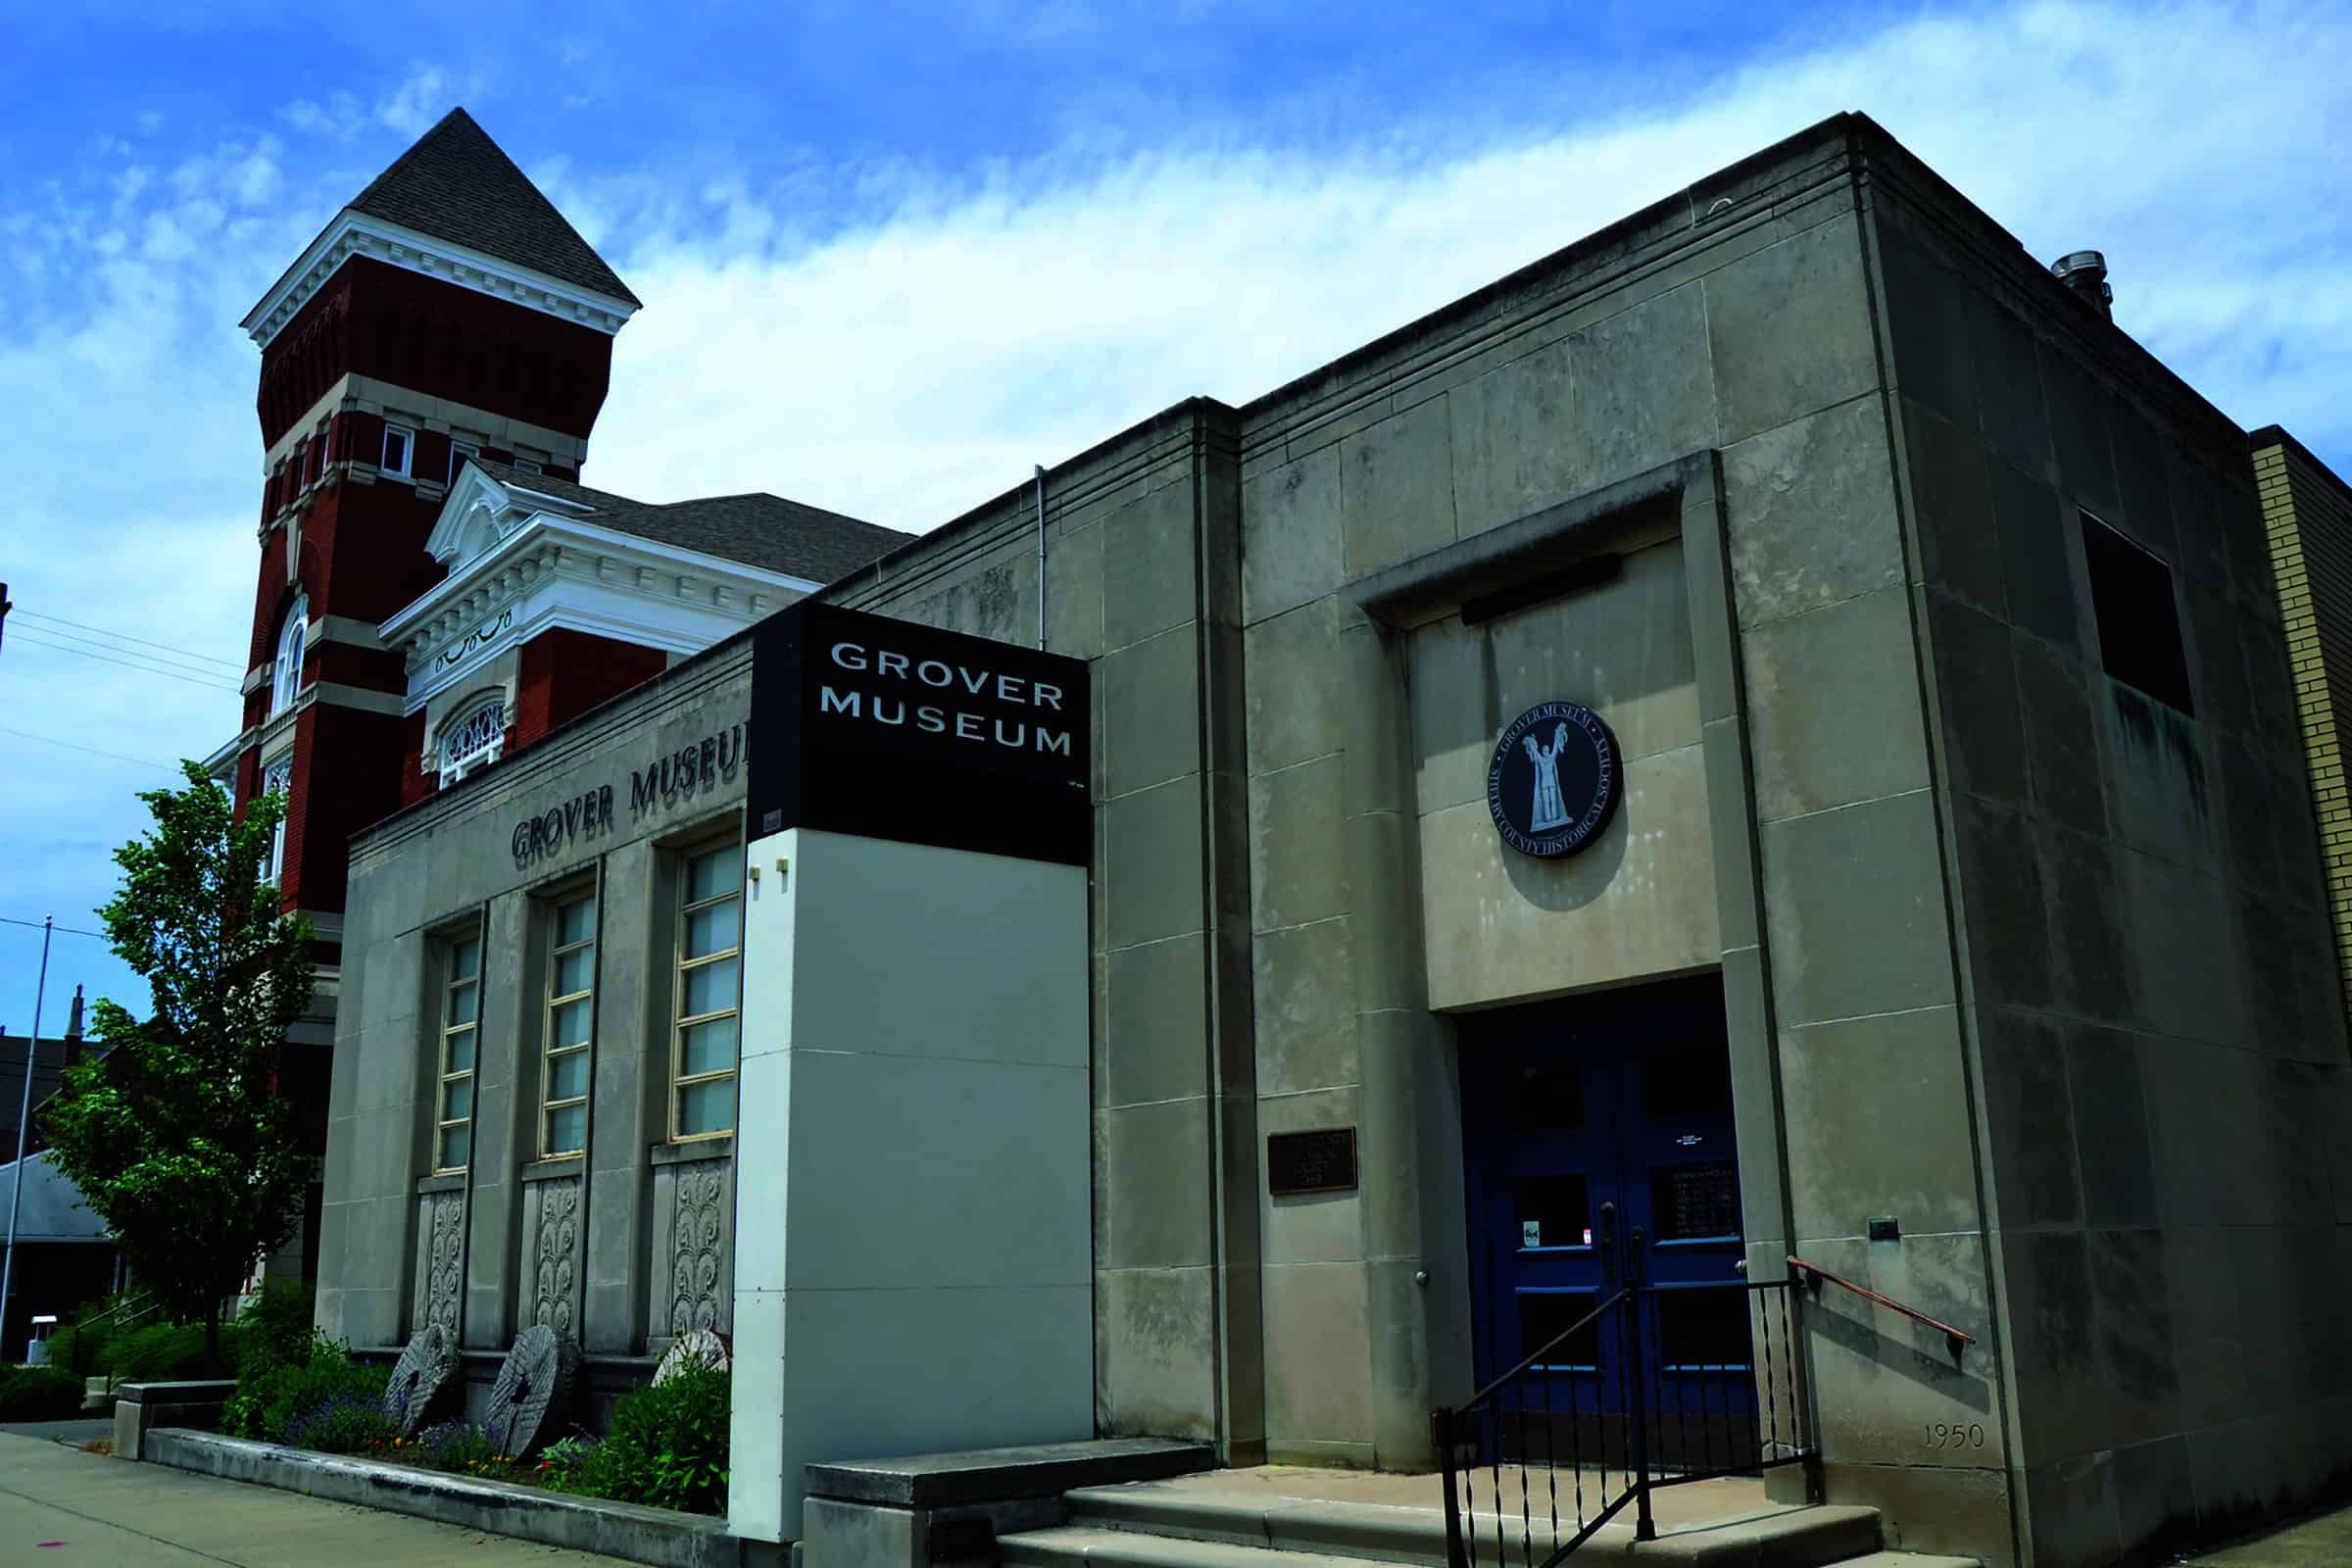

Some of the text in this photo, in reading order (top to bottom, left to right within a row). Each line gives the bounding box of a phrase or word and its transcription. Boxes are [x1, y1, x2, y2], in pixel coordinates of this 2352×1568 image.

[830, 642, 1063, 710] GROVER
[820, 686, 1072, 757] MUSEUM
[1499, 705, 1592, 752] GROVER MUSEUM
[512, 784, 614, 860] GROVER
[1542, 801, 1605, 855] HISTORICAL
[1925, 1423, 1984, 1448] 1950
